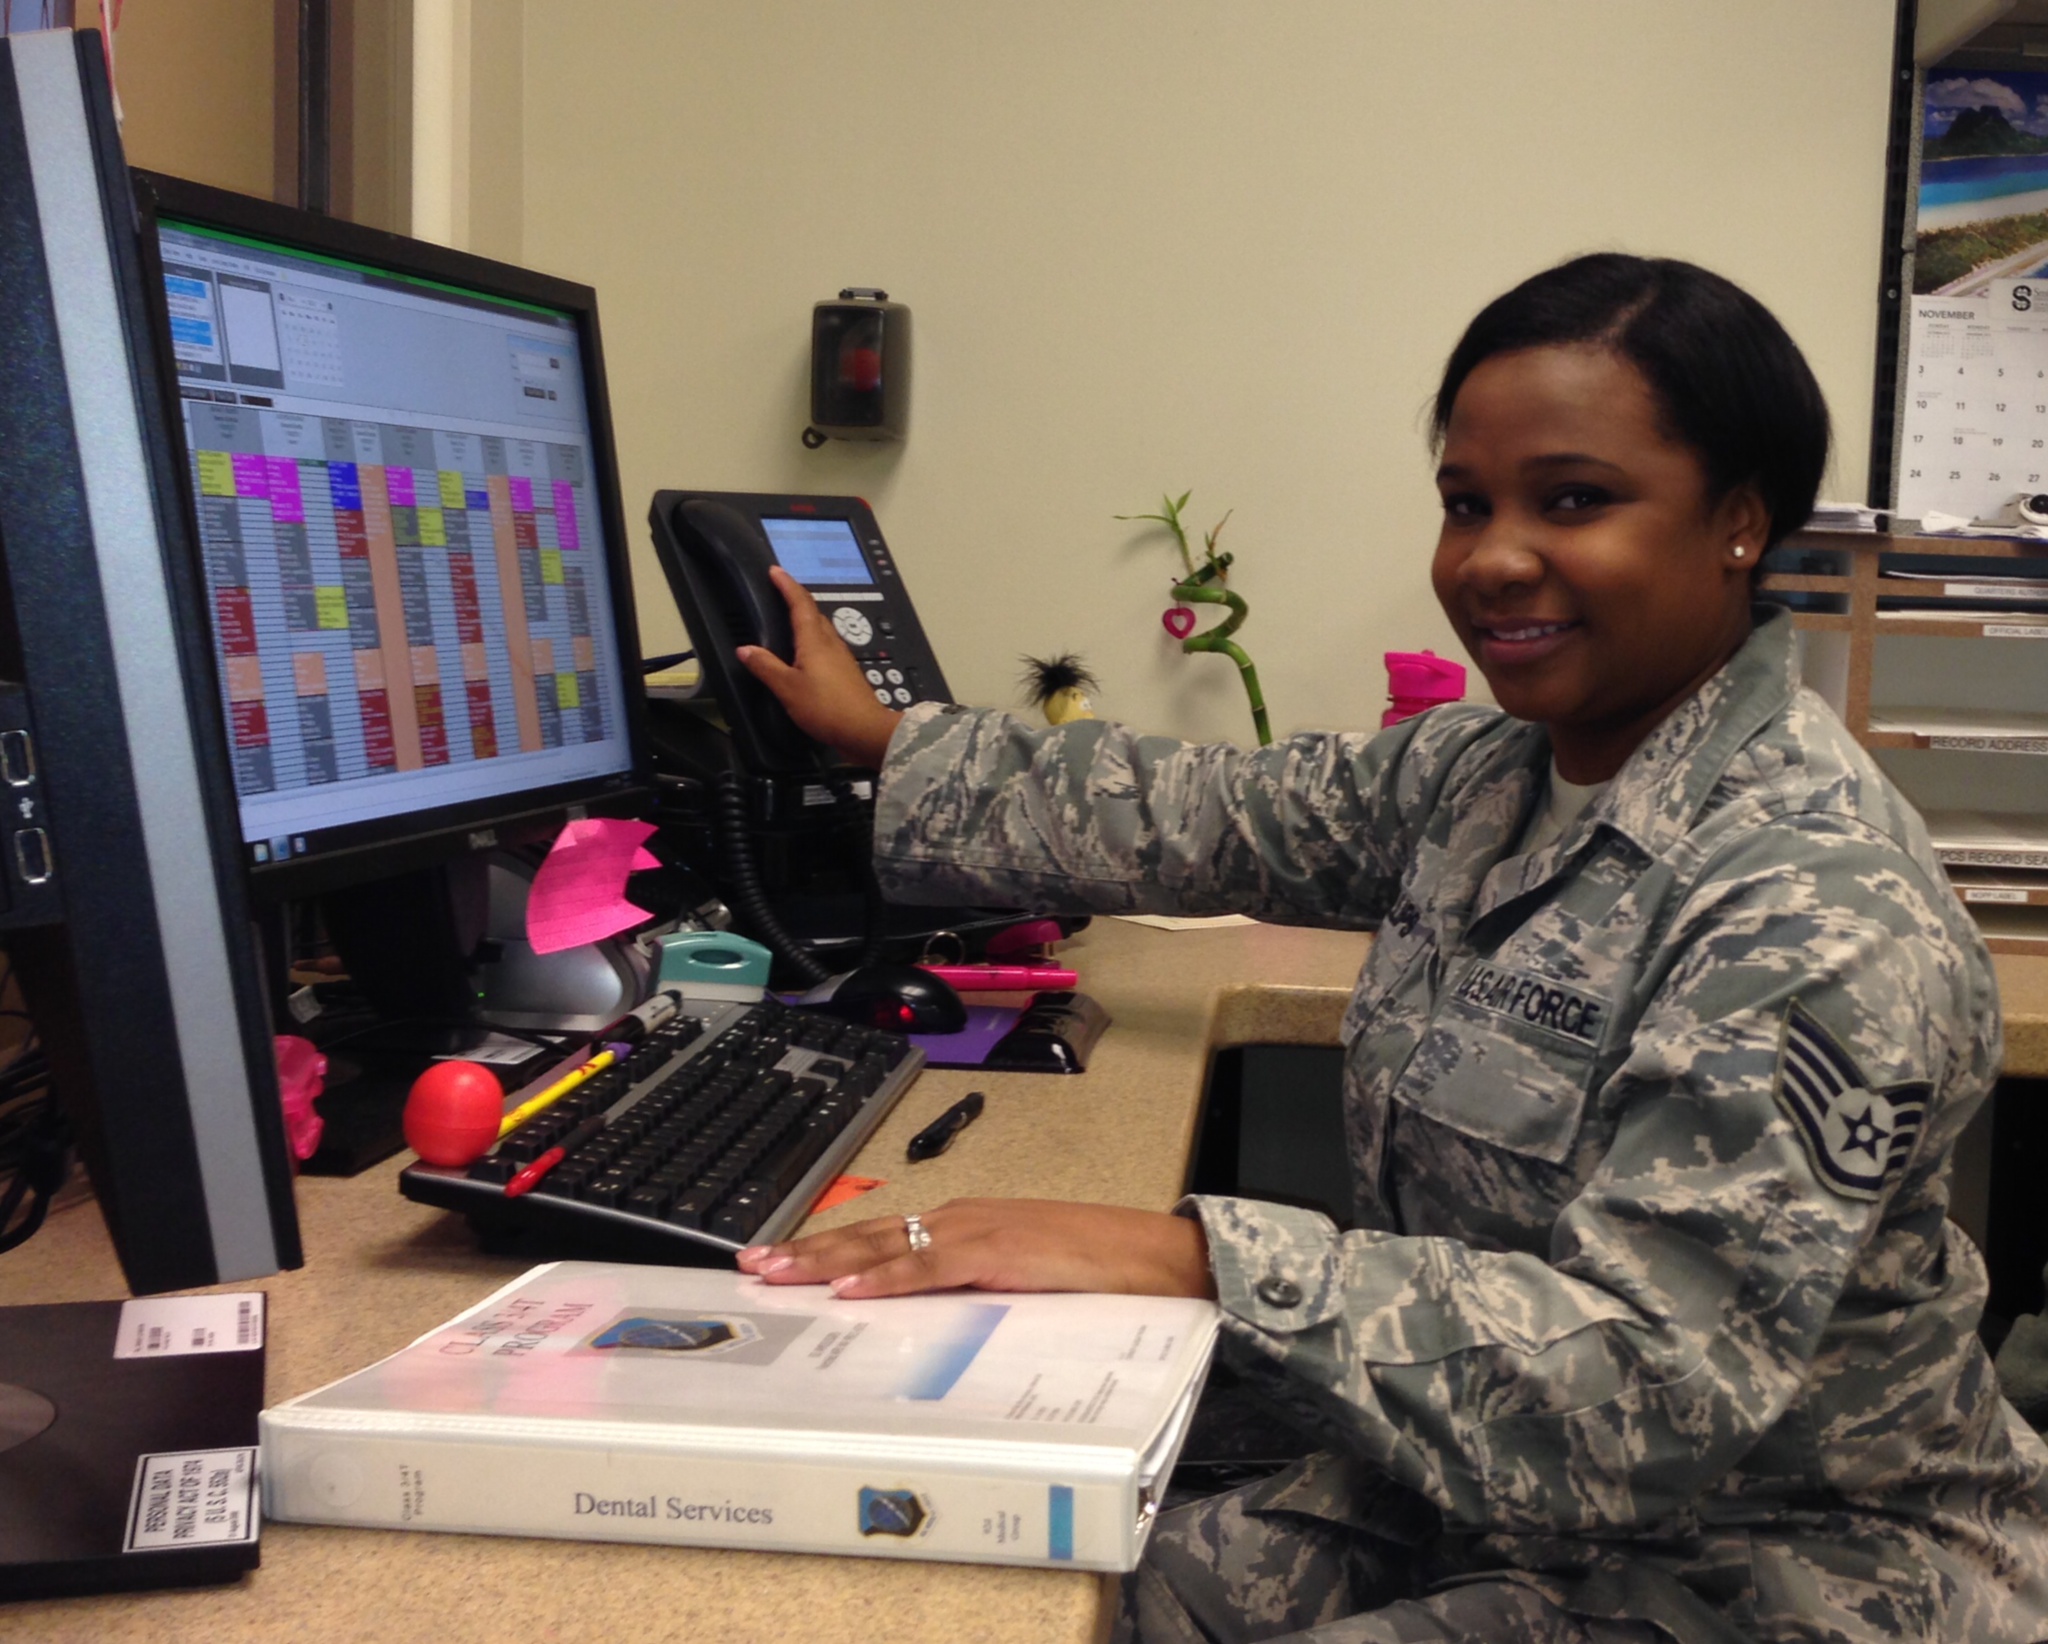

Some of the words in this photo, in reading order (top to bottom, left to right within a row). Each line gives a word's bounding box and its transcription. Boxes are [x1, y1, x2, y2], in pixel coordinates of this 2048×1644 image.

[1918, 309, 1976, 320] NOVEMBER
[1918, 365, 1925, 374] 3
[1957, 367, 1964, 375] 4
[1997, 368, 2005, 377] 5
[2037, 370, 2044, 378] 6
[1916, 400, 1927, 409] 10
[1955, 402, 1966, 410] 11
[1996, 403, 2007, 412] 12
[2035, 404, 2046, 413] 13
[1913, 435, 1924, 443] 17
[1953, 436, 1963, 445] 18
[1992, 438, 2003, 446] 19
[2031, 439, 2044, 448] 20
[1909, 469, 1922, 478] 24
[1949, 471, 1961, 480] 25
[1988, 472, 2001, 481] 26
[2028, 474, 2040, 483] 27
[1932, 736, 1986, 749] RECORD
[1988, 739, 2048, 752] ADDRESS
[1940, 850, 1966, 861] PCS
[1968, 852, 2022, 864] RECORD
[1509, 979, 1600, 1040] FORCE
[439, 1320, 514, 1355] CLASS
[492, 1303, 594, 1356] PROGRAM
[182, 1459, 204, 1475] 1974
[151, 1469, 173, 1490] DATA
[180, 1475, 201, 1487] OF
[177, 1488, 200, 1503] ACT
[413, 1470, 425, 1515] Program
[144, 1491, 171, 1533] PERSONAL
[574, 1492, 657, 1518] Dental
[666, 1496, 774, 1525] Services
[173, 1505, 198, 1539] PRIVACY
